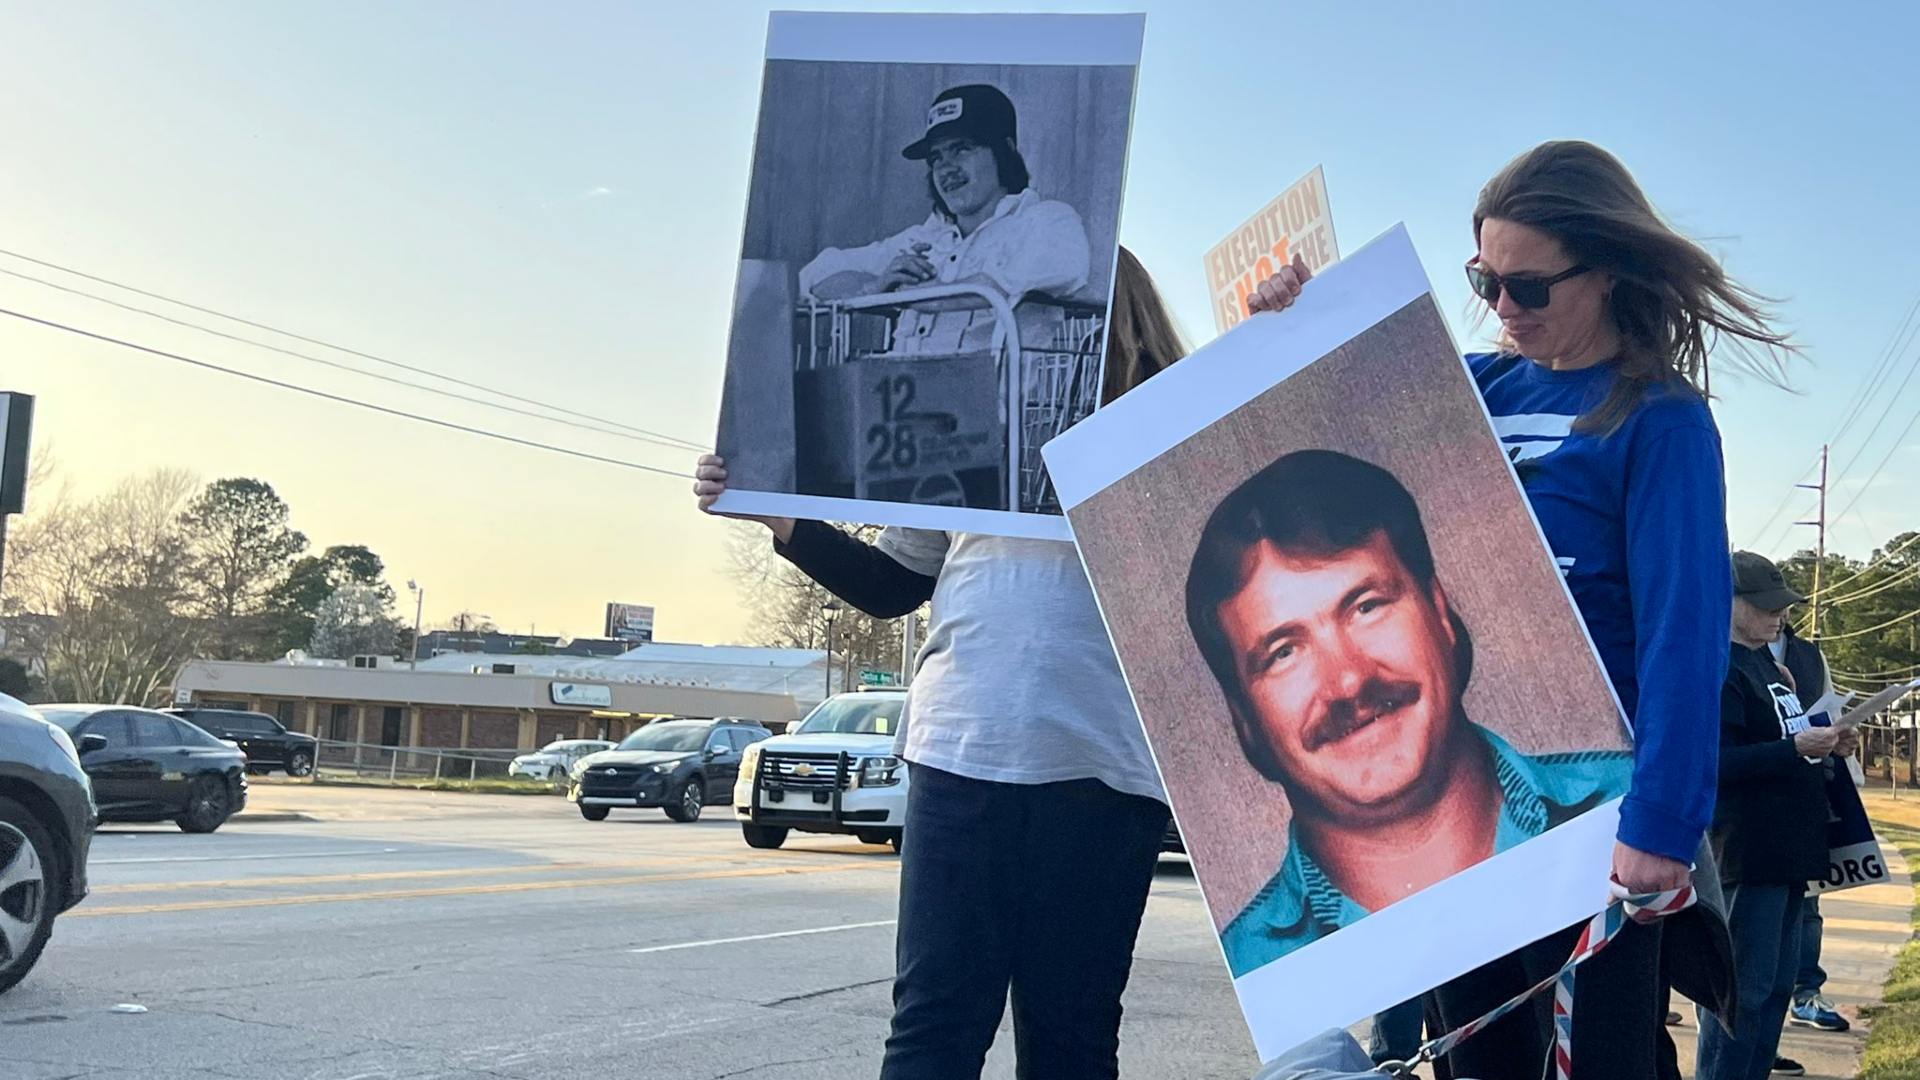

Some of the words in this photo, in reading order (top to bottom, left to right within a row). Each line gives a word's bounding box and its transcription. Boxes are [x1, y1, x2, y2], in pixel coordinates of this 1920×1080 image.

[1210, 176, 1321, 292] EXECUTION
[1218, 290, 1240, 332] IS
[1235, 233, 1290, 320] NOT
[871, 373, 916, 422] 12
[865, 423, 918, 473] 28
[1804, 854, 1884, 892] .ORG
